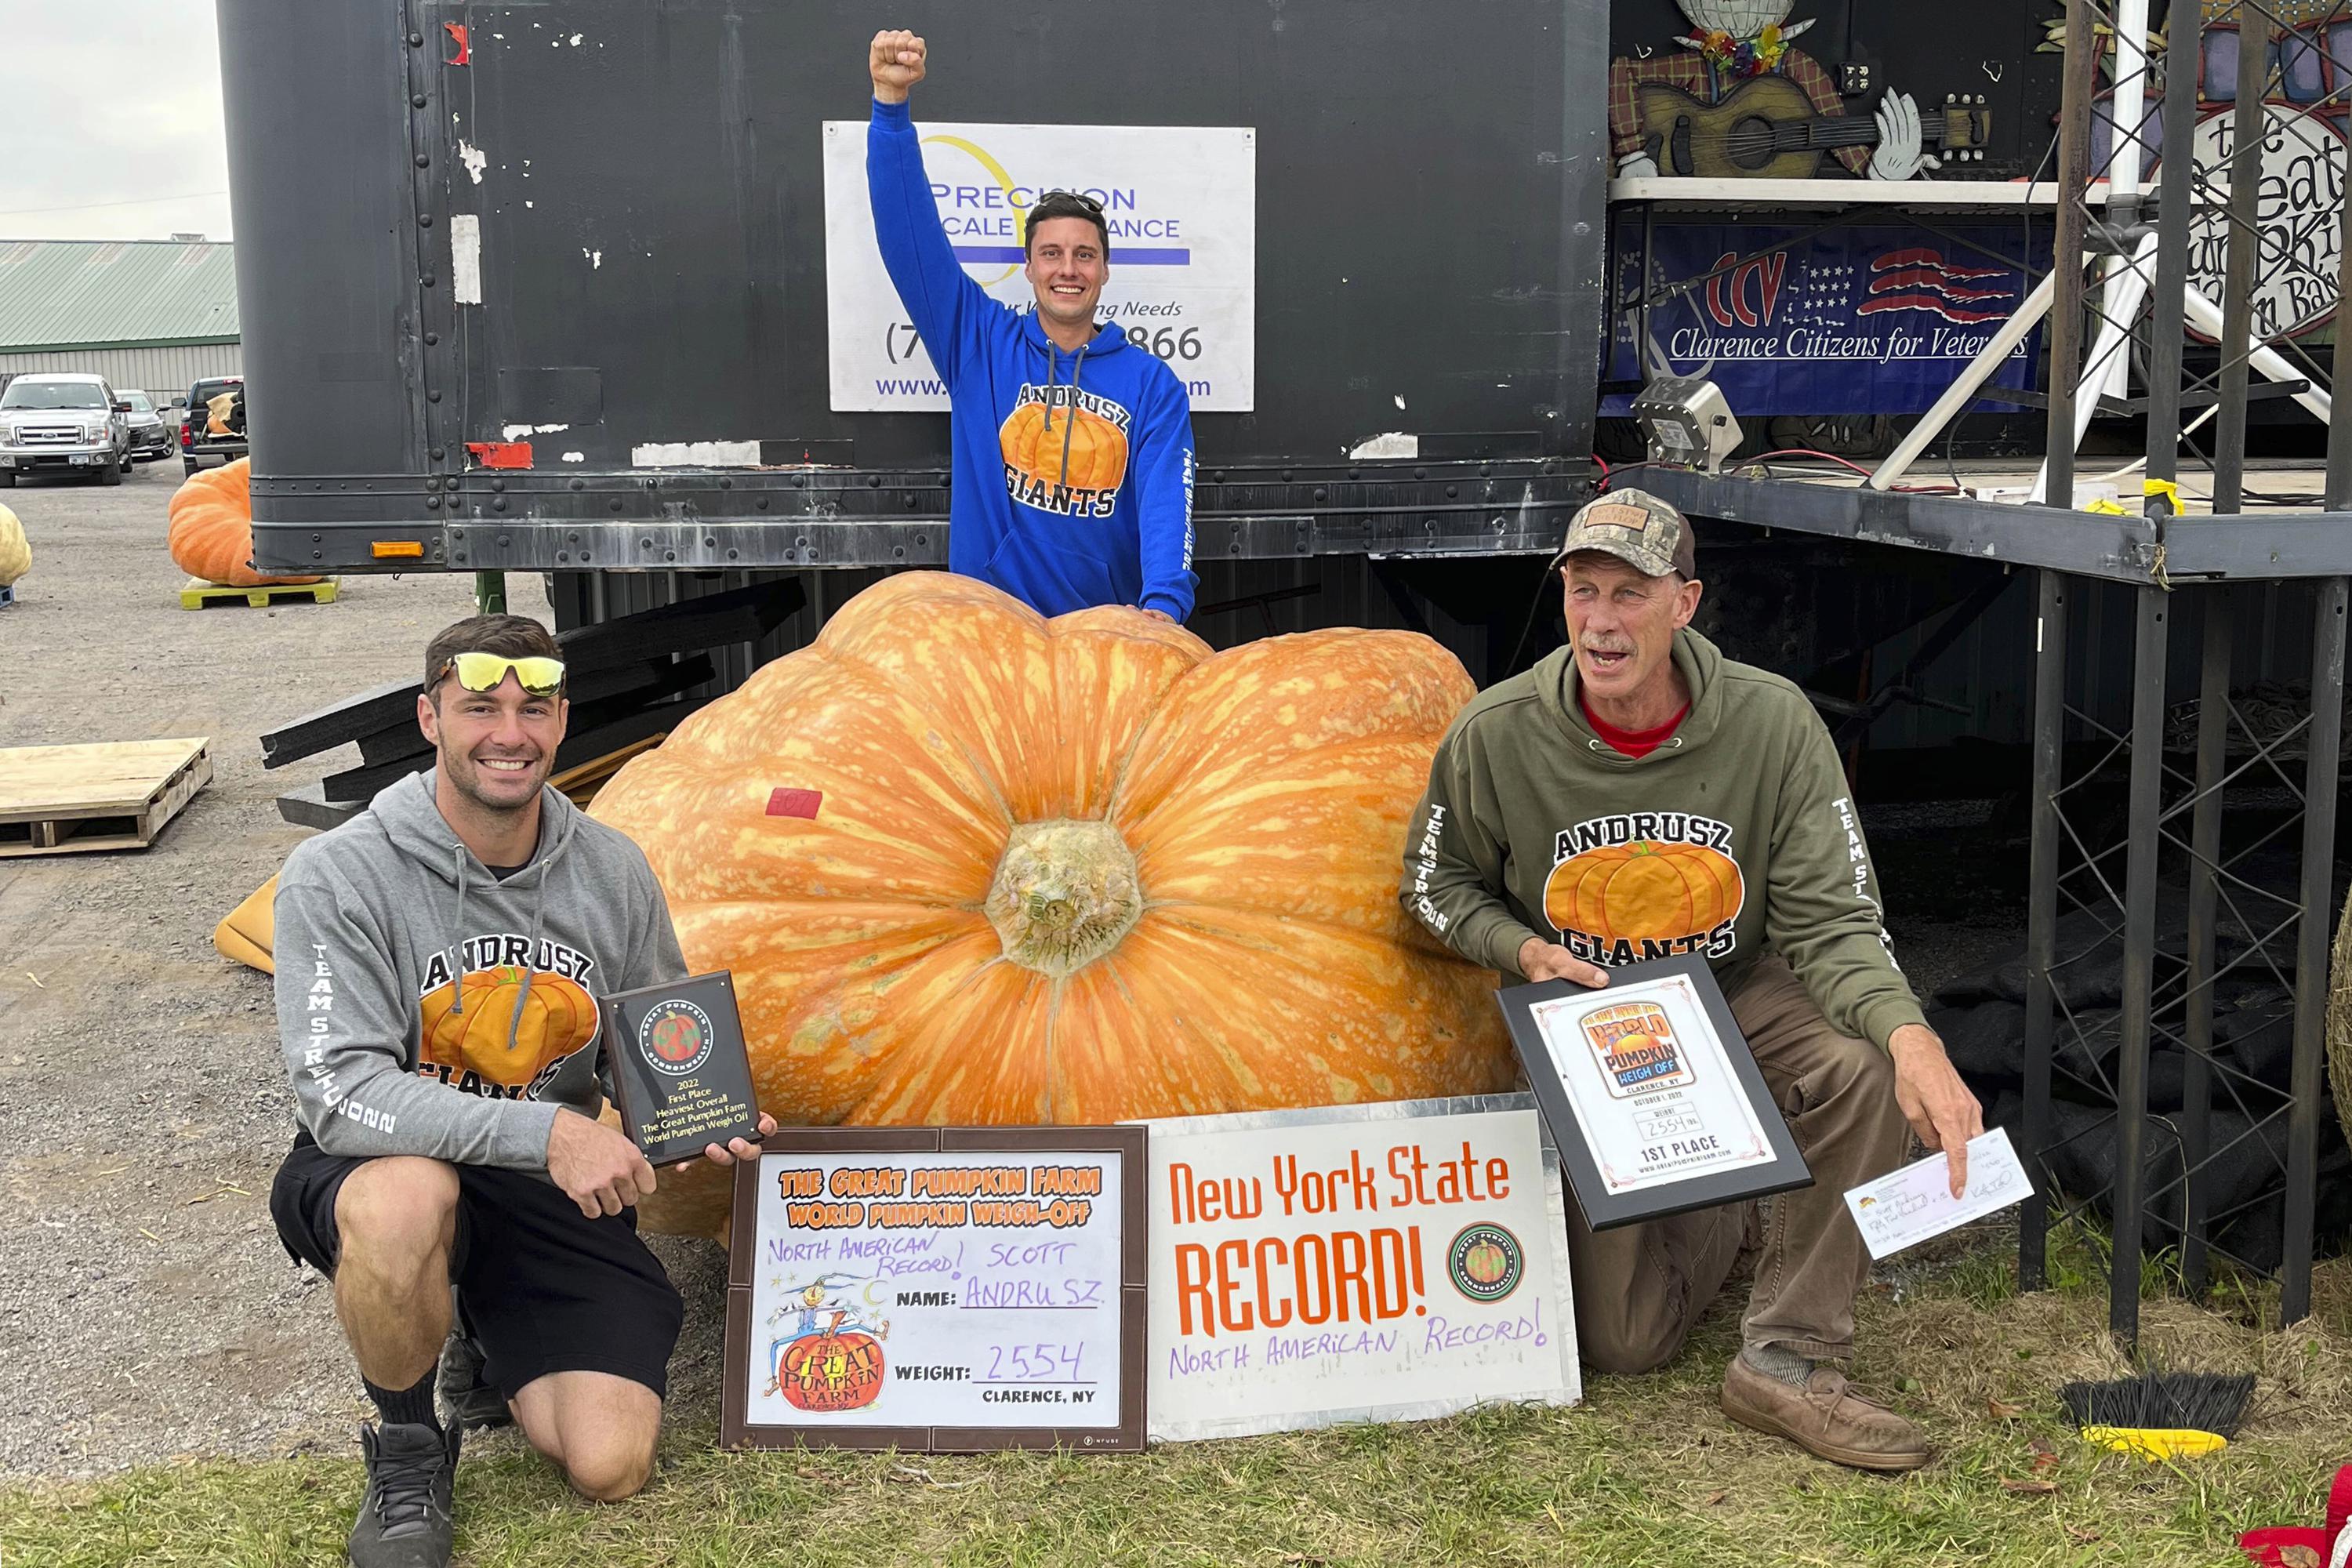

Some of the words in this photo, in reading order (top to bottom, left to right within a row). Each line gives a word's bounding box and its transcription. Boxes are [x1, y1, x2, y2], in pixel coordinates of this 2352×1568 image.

[943, 216, 1013, 236] CALE
[1108, 220, 1180, 238] ANCE
[1706, 251, 1787, 327] CCV
[1123, 301, 1181, 316] Needs
[1670, 328, 1777, 358] Clarence
[1787, 328, 1879, 358] Citizens
[1880, 329, 1924, 365] for
[1932, 328, 2027, 358] Veters
[1017, 383, 1131, 432] ANDRUSZ
[1004, 464, 1116, 517] GIANTS
[1418, 803, 1446, 861] TEAM
[1554, 812, 1733, 863] ANDRUSZ
[1831, 797, 1865, 862] TEAM
[1562, 917, 1736, 966] GIANTS
[307, 944, 333, 1011] TEAM
[422, 933, 594, 993] ANDRUSZ
[666, 1003, 706, 1025] PUMPKIN
[1603, 1044, 1679, 1071] PUMPKIN
[1618, 1068, 1652, 1084] WEIGH
[1655, 1060, 1675, 1074] OFF
[668, 1091, 687, 1104] First
[688, 1088, 712, 1099] Place
[677, 1078, 699, 1091] 2022
[641, 1123, 659, 1134] The
[660, 1116, 687, 1130] Great
[688, 1107, 724, 1123] Pumpkin
[725, 1102, 746, 1114] Farm
[656, 1103, 695, 1119] Heaviest
[696, 1094, 728, 1109] Overall
[644, 1133, 671, 1145] World
[671, 1124, 705, 1140] Pumpkin
[706, 1116, 733, 1130] Weigh
[735, 1112, 749, 1122] Off
[1647, 1116, 1687, 1137] 2554
[1641, 1145, 1668, 1163] 1ST
[1671, 1135, 1720, 1156] PLACE
[779, 1168, 824, 1200] THE
[830, 1167, 907, 1198] GREAT
[911, 1167, 1029, 1197] PUMPKIN
[1031, 1167, 1102, 1196] FARM
[1170, 1162, 1263, 1224] New
[1273, 1149, 1377, 1216] York
[1387, 1142, 1509, 1207] State
[786, 1200, 866, 1229] WORLD
[868, 1200, 967, 1229] PUMPKIN
[971, 1200, 1094, 1229] WEIGH-OFF
[768, 1239, 833, 1265] NORTH
[987, 1241, 1078, 1267] SCOTT
[1175, 1225, 1427, 1338] RECORD!
[896, 1293, 956, 1307] NAME:
[785, 1341, 878, 1376] GREAT
[817, 1345, 842, 1355] THE
[987, 1341, 1084, 1381] 2554
[1169, 1344, 1250, 1380] NORTH
[895, 1365, 970, 1381] WEIGHT:
[800, 1390, 860, 1403] FARM
[982, 1390, 1068, 1405] CLARENCE,
[1073, 1390, 1095, 1404] NY
